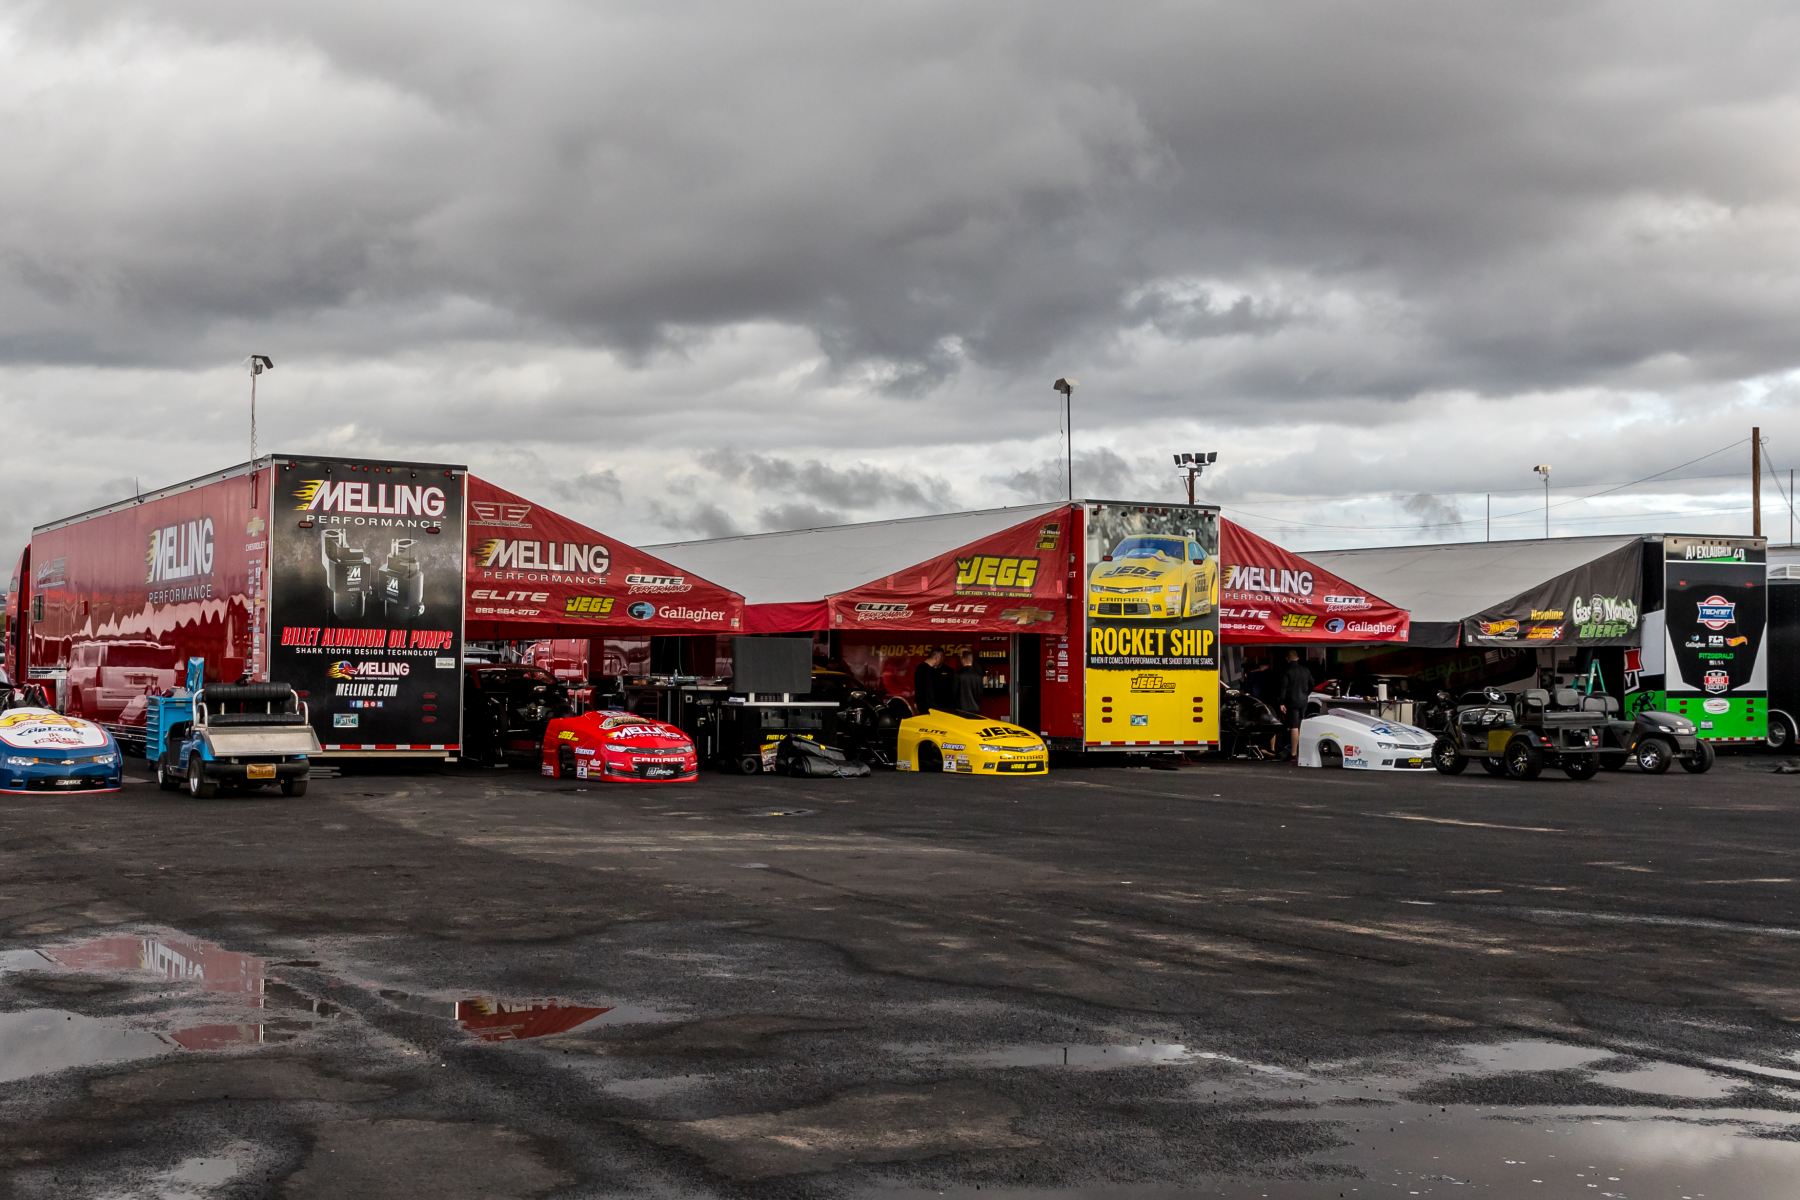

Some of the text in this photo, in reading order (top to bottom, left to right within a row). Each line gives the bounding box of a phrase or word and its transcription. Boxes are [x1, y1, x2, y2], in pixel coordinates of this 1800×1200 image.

[308, 480, 445, 517] MELLING
[306, 515, 442, 528] PERFORMANCE
[151, 518, 214, 583] MELLING
[485, 538, 609, 573] MELLING
[484, 571, 608, 585] PERFORMANCE
[957, 556, 1038, 587] JEGS
[626, 574, 684, 586] ELITE
[1225, 565, 1313, 595] MELLING
[149, 584, 212, 604] PERFORMANCE
[471, 589, 550, 602] ELITE
[1225, 592, 1313, 605] PERFORMANCE
[1325, 596, 1365, 604] ELITE
[566, 596, 615, 613] JEGS
[856, 603, 908, 611] ELITE
[928, 604, 988, 614] ELITE
[659, 605, 726, 622] Gallagher
[1220, 608, 1272, 619] ELITE
[1281, 613, 1318, 627] JEGS
[1530, 609, 1564, 620] Havoline
[1347, 620, 1397, 634] Gallagher
[281, 626, 453, 650] BILLET ALUMINUM OIL PUMPS
[1090, 627, 1214, 657] ROCKET SHIP
[354, 648, 384, 656] DESIGN
[386, 649, 439, 657] TECHNOLOGY
[869, 644, 974, 657] 1-800-34554
[356, 661, 410, 676] MELLING
[1708, 676, 1725, 684] SPEED
[335, 683, 398, 697] MELLING.COM
[613, 726, 681, 738] MELLING
